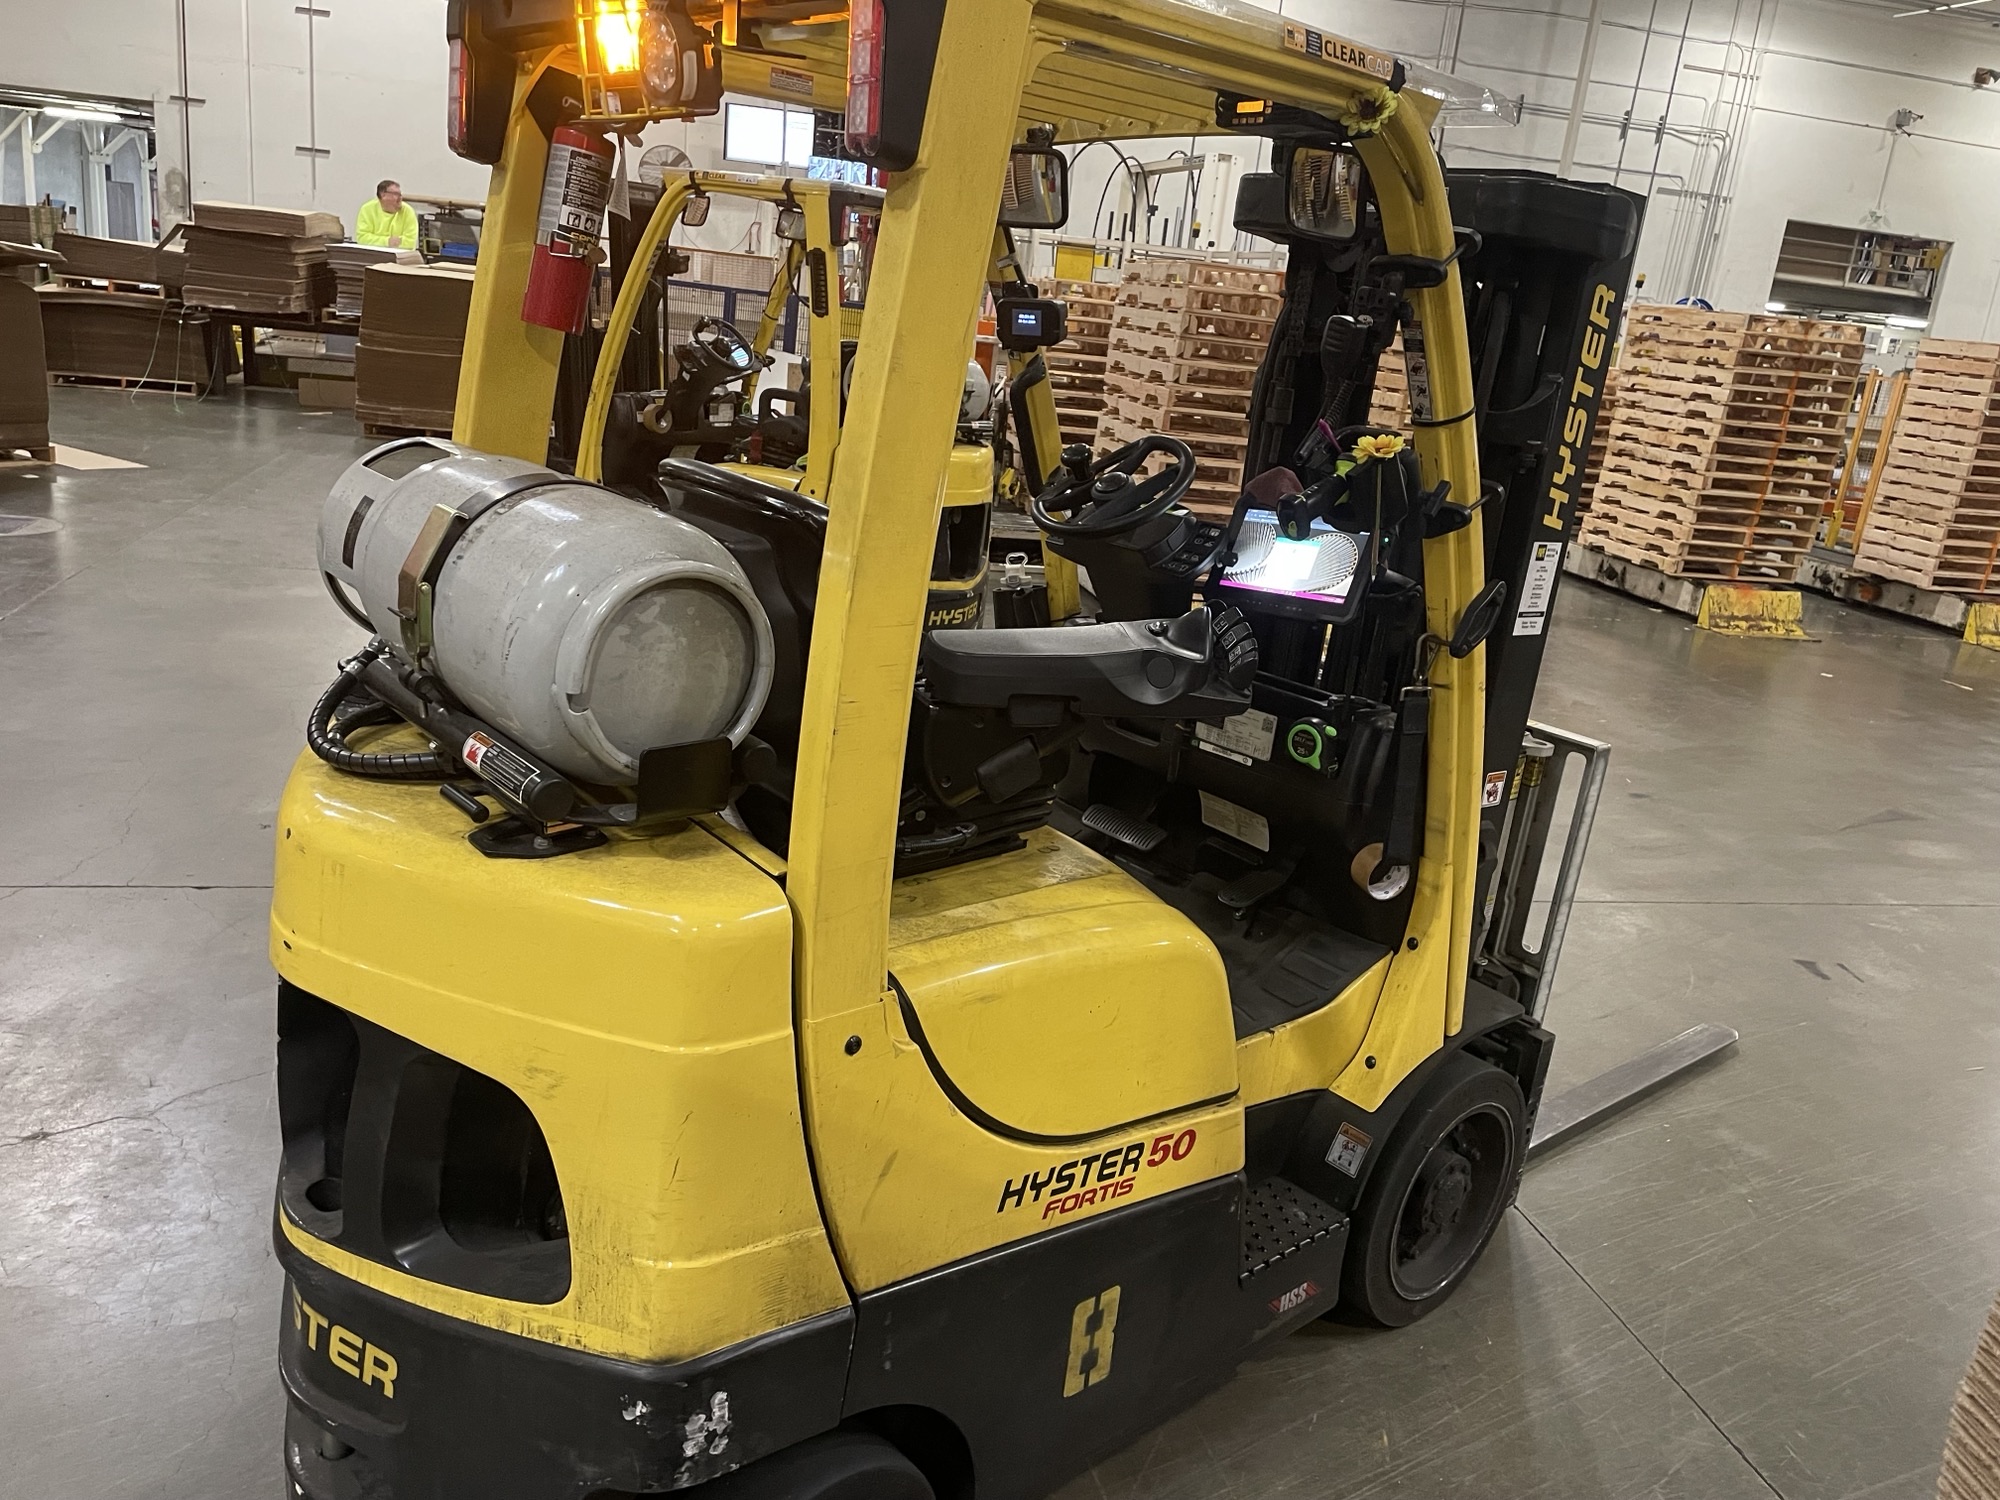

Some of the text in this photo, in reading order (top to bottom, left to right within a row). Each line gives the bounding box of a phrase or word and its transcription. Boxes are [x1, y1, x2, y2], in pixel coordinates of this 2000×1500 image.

[1542, 283, 1616, 531] HYSTER
[928, 600, 978, 626] HYSTER
[997, 1129, 1197, 1213] HYSTER 50
[1041, 1176, 1136, 1220] FORTIS
[1279, 1282, 1308, 1313] HSS
[1063, 1284, 1122, 1398] 8
